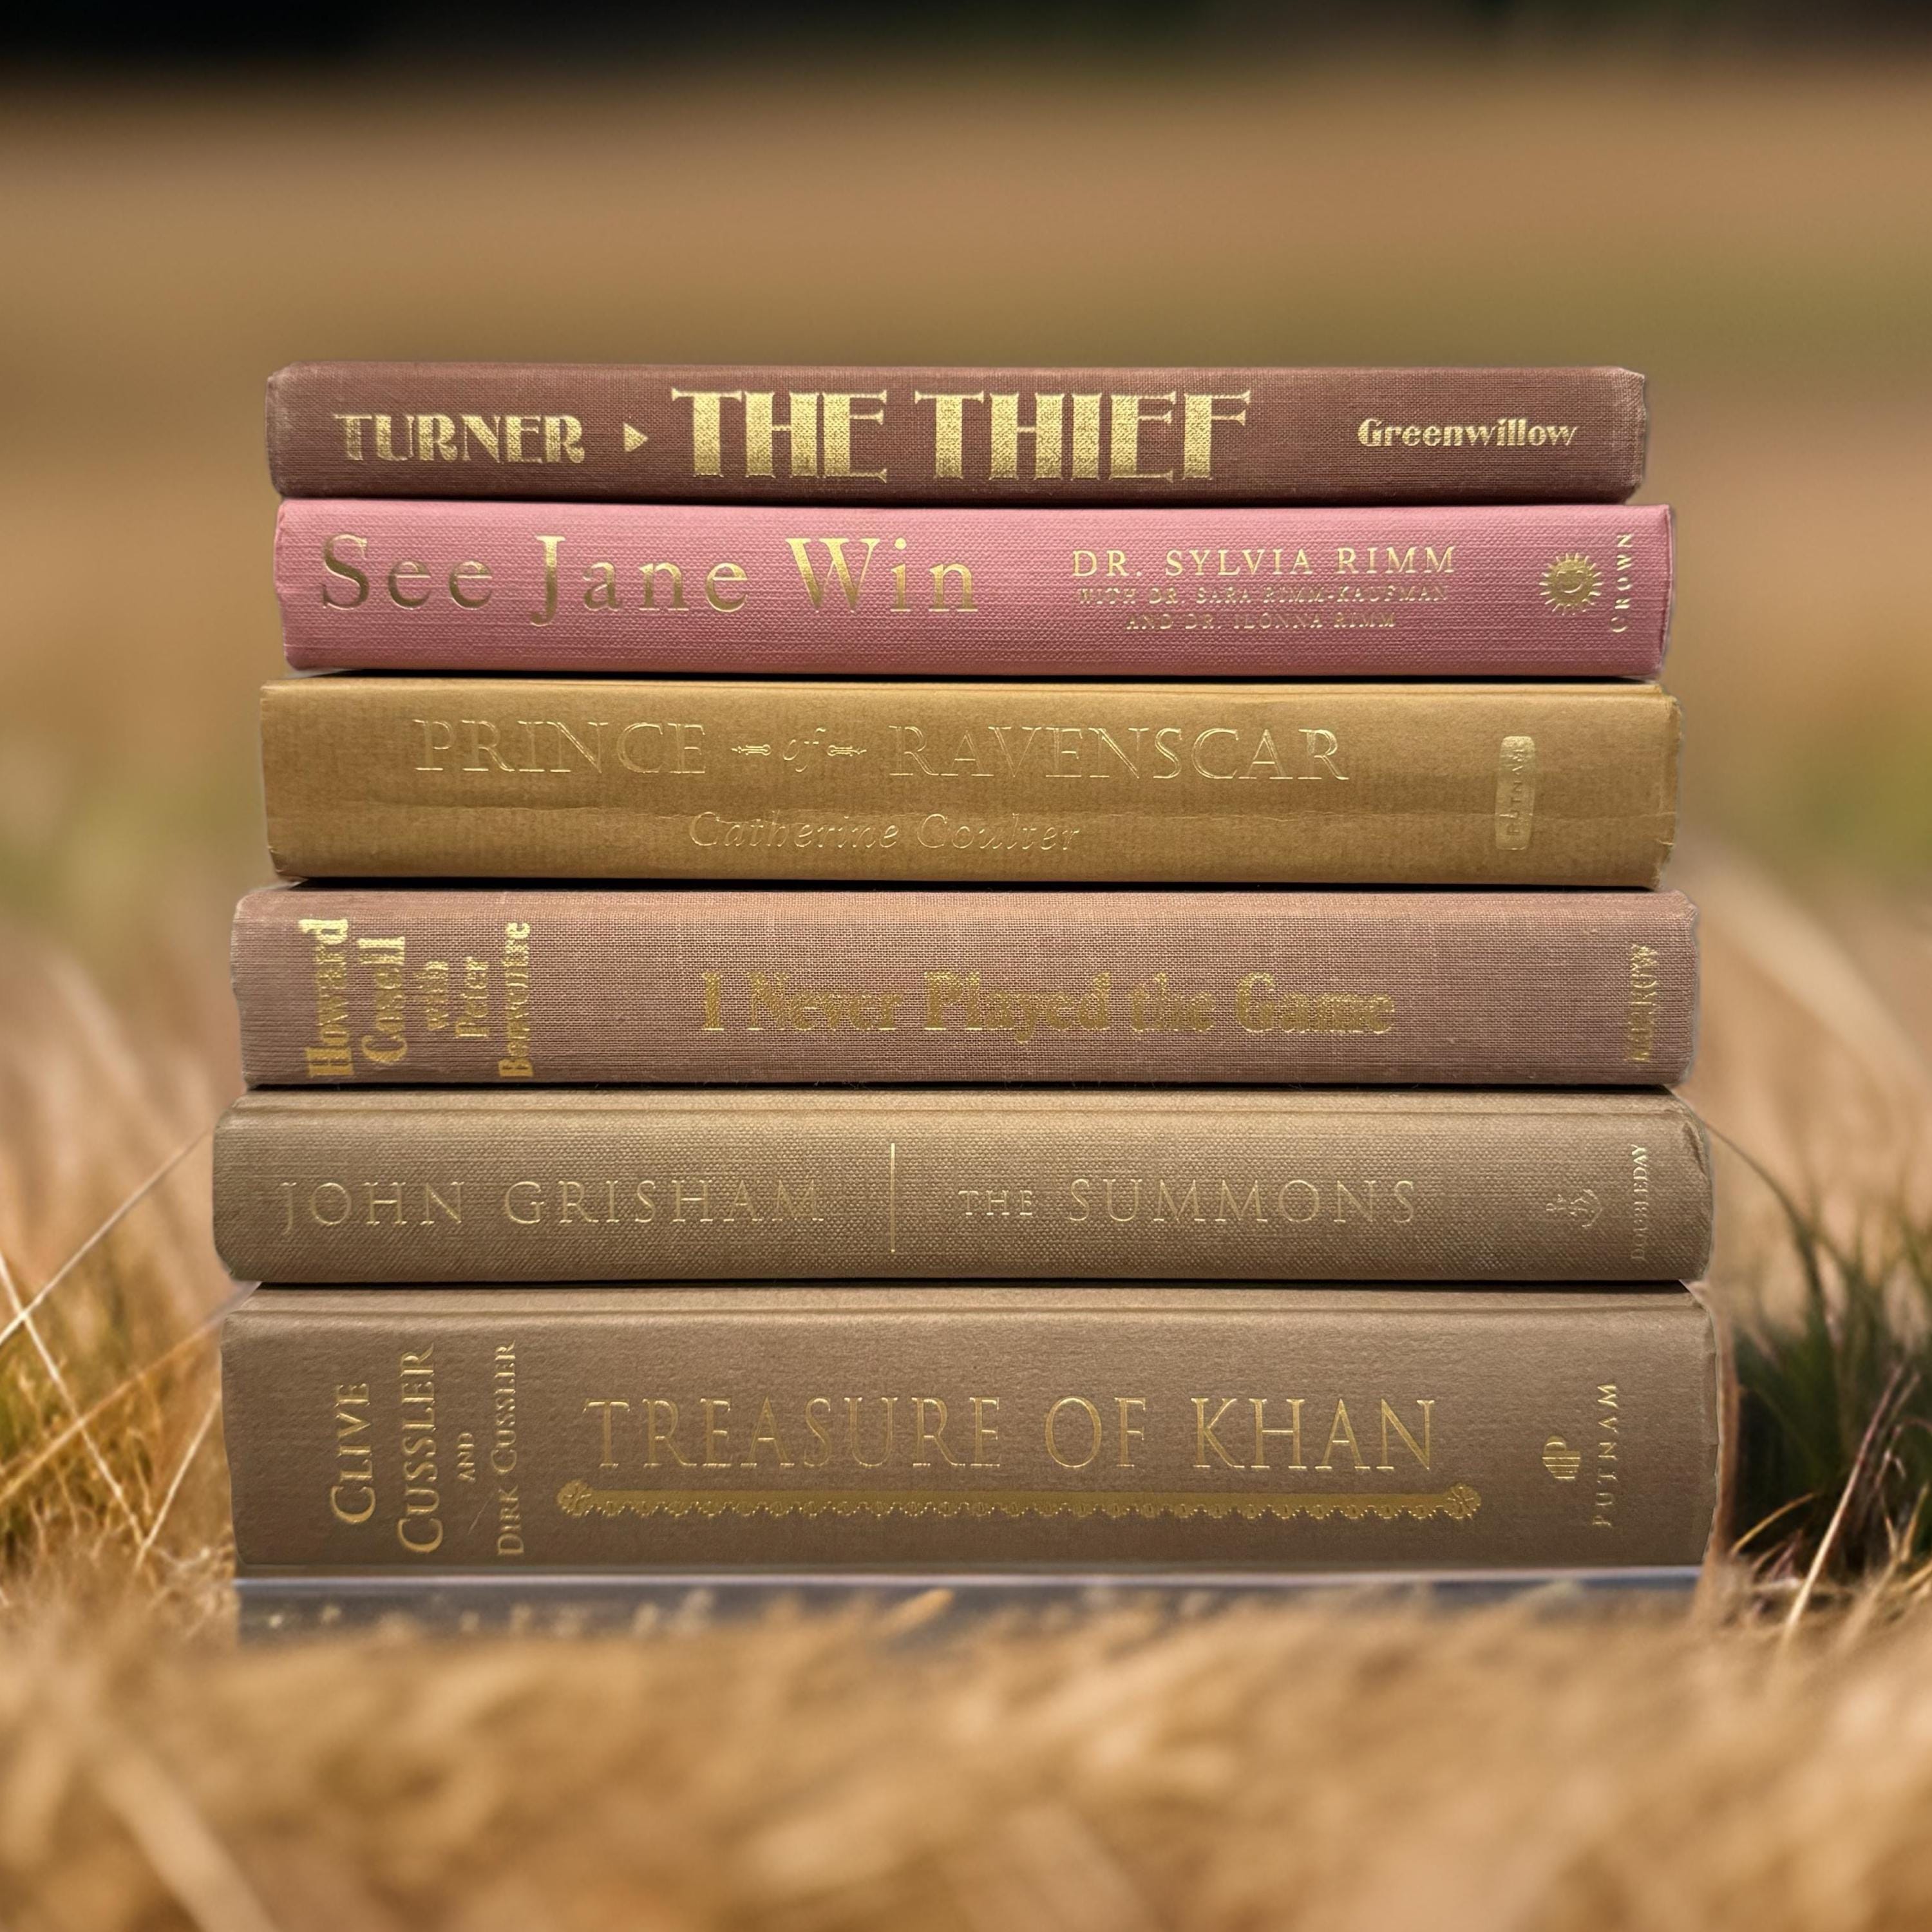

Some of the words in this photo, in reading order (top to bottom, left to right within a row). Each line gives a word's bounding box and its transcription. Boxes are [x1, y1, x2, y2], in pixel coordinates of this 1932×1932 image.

[333, 413, 585, 464] TURNER
[671, 388, 887, 484] THE
[914, 390, 1251, 481] THIEF
[1357, 418, 1578, 447] Greenwillow
[321, 533, 494, 611] See
[529, 535, 748, 627] Jane
[786, 536, 979, 613] Win
[1072, 549, 1143, 578] DR.
[1164, 548, 1314, 577] SYLVIA
[1336, 545, 1456, 574] RIMM
[1077, 587, 1137, 605] WITH
[1148, 587, 1186, 605] DR.
[1195, 586, 1253, 604] SARA
[1610, 533, 1634, 634] CROWN
[1126, 612, 1174, 630] AND
[1233, 611, 1323, 630] ILONNA
[1333, 611, 1397, 629] RIMM
[412, 719, 706, 773] PRINCE
[782, 726, 827, 773] of
[889, 724, 1349, 781] RAVENSCAR
[688, 810, 900, 849] Catherine
[916, 812, 1081, 851] Coulter
[298, 919, 354, 1077] Howard
[356, 936, 408, 1065] Cosell
[455, 956, 489, 1039] Peter
[702, 971, 724, 1030] I
[747, 971, 904, 1031] Never
[923, 970, 1112, 1043] Played
[1131, 971, 1217, 1032] the
[1236, 971, 1396, 1035] Game
[280, 1180, 465, 1236] JOHN
[504, 1179, 825, 1225] GRISHAM
[958, 1189, 1035, 1216] THE
[1068, 1178, 1416, 1224] SUMMONS
[1631, 1144, 1649, 1263] DOUBLEDAY
[491, 1340, 517, 1476] CUSSLER
[582, 1397, 1001, 1468] TREASURE
[1045, 1396, 1146, 1468] OF
[1191, 1397, 1435, 1470] KHAN
[330, 1383, 376, 1524] CLIVE
[397, 1342, 444, 1554] CUSSLER
[457, 1432, 476, 1483] AND
[1591, 1384, 1619, 1528] PUTNAM
[498, 1484, 525, 1556] DIRK
